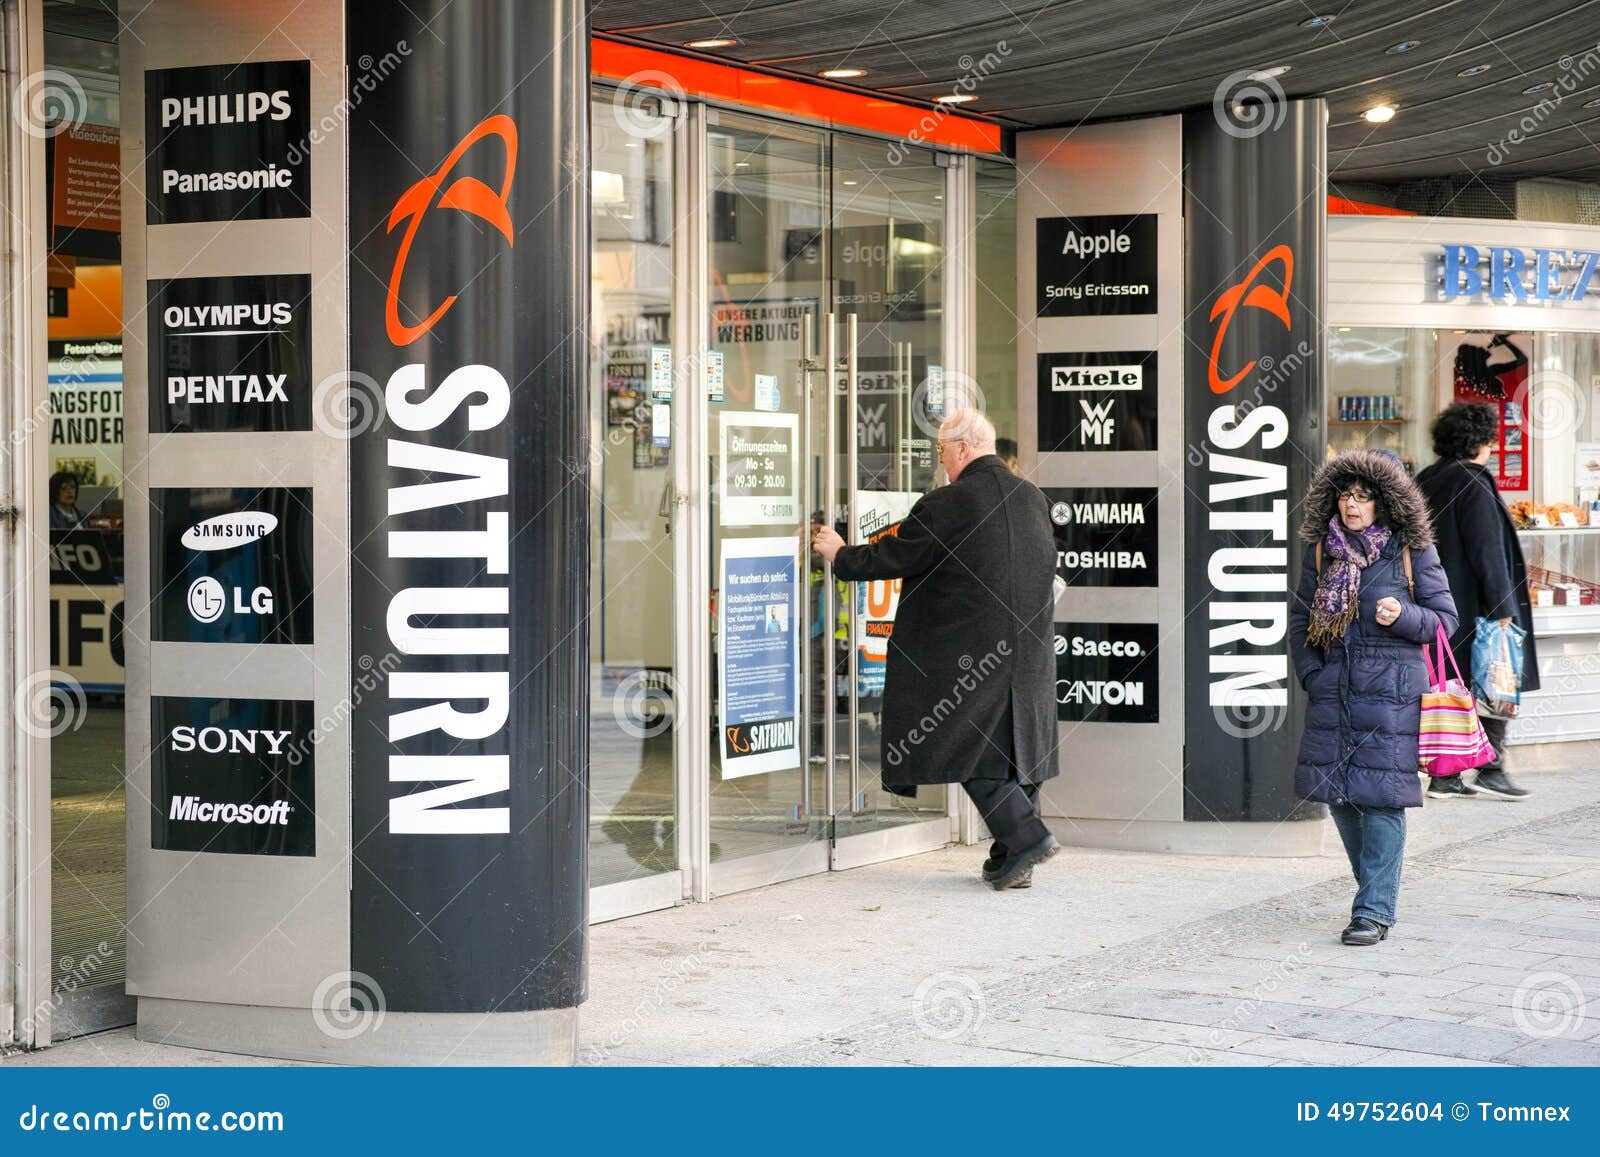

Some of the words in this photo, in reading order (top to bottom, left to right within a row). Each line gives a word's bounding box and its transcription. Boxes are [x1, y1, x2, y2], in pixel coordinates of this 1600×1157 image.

[161, 90, 292, 127] PHILIPS
[162, 164, 293, 194] Panasonic
[1062, 229, 1131, 259] Apple
[1046, 285, 1082, 299] Sony
[1085, 284, 1149, 296] Ericsson
[164, 303, 292, 328] OLYMPUS
[717, 308, 758, 321] UNSERE
[718, 323, 800, 343] WERBUNG
[168, 374, 288, 404] PENTAX
[1055, 370, 1138, 386] Miele
[51, 418, 123, 444] ANDER
[732, 436, 787, 455] Öffnungszeiten
[746, 458, 758, 470] Mo
[764, 458, 774, 470] Sa
[735, 475, 757, 488] 09.30
[1073, 503, 1145, 524] YAMAHA
[193, 523, 266, 538] SAMSUNG
[1056, 551, 1147, 568] TOSHIBA
[1208, 404, 1289, 707] SATURN
[233, 586, 273, 615] LG
[386, 363, 511, 835] SATURN
[1071, 637, 1141, 657] Saeco
[1056, 680, 1144, 705] CANTON
[171, 726, 291, 755] SONY
[750, 720, 793, 752] SATURN
[169, 795, 290, 825] Microsoft
